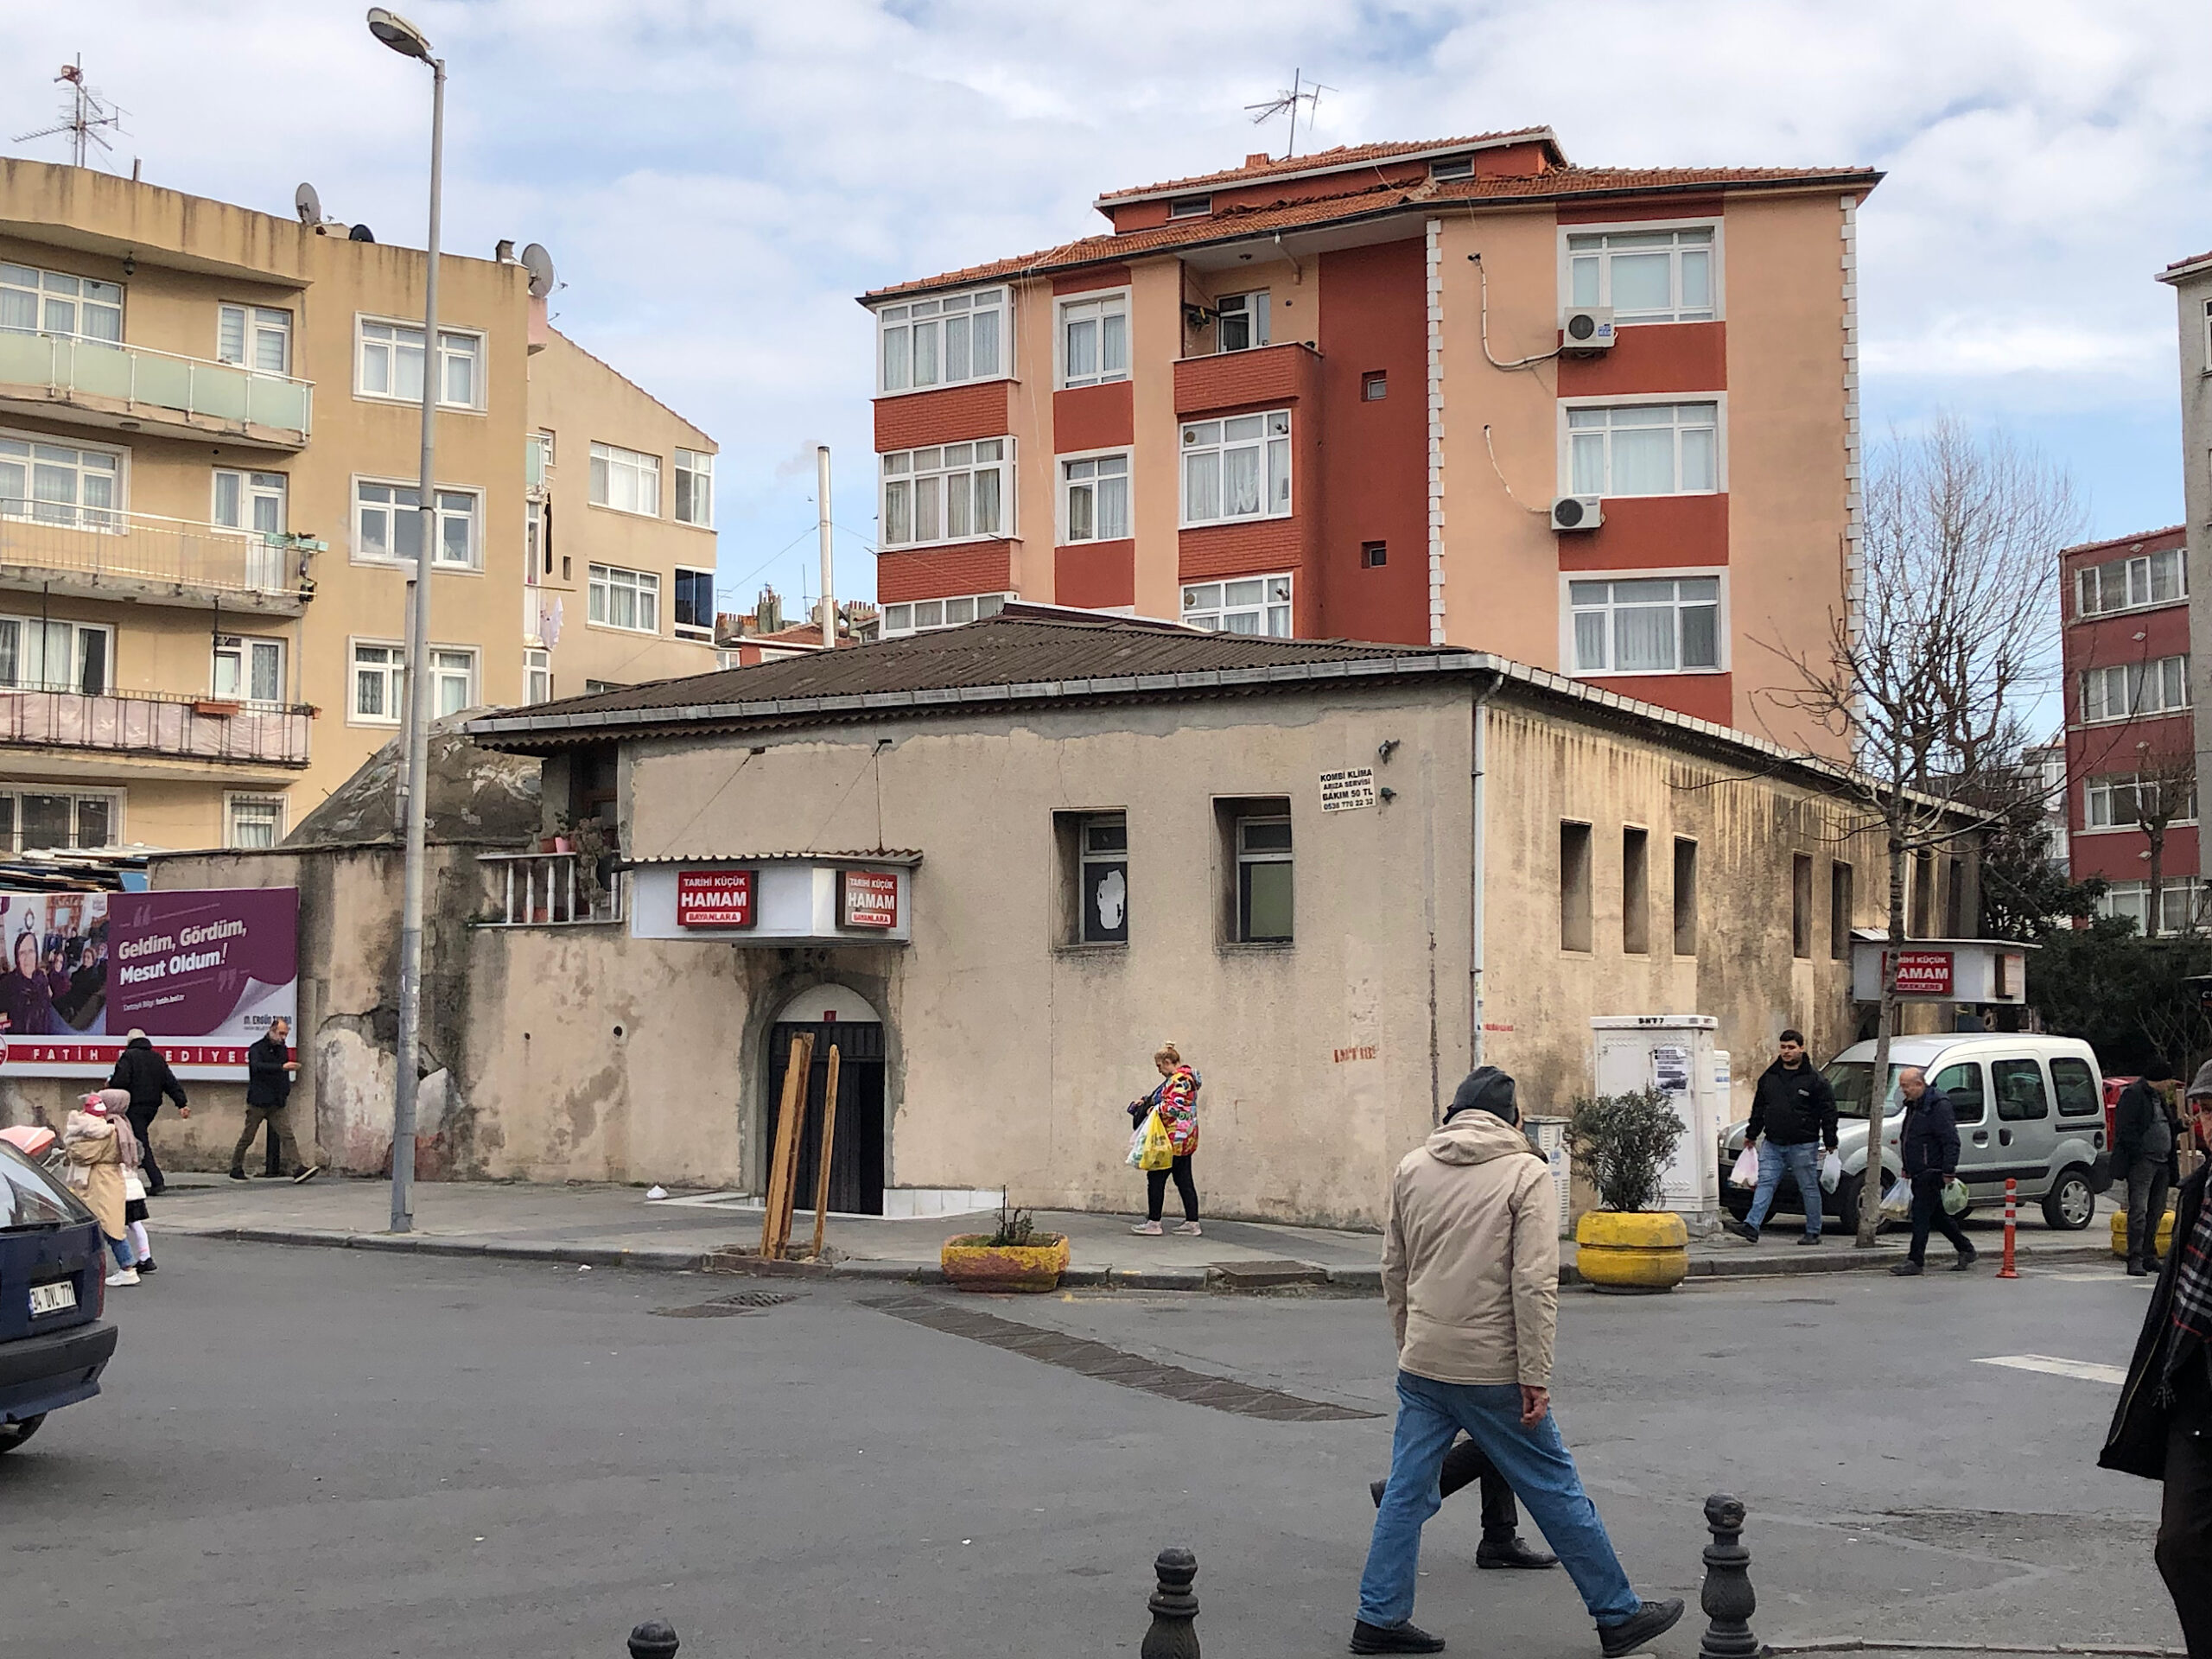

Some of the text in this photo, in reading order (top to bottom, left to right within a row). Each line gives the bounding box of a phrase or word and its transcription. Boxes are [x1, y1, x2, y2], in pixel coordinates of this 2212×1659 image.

[1322, 791, 1349, 801] BAKIM
[715, 875, 746, 888] KÜÇÜK
[681, 891, 747, 907] HAMAM
[848, 892, 895, 910] HAMAM
[688, 912, 738, 921] BAYANLARA
[118, 918, 247, 960] Geldim, Gördüm,
[119, 942, 229, 986] Mesut Oldum!
[1916, 955, 1947, 965] KÜÇÜK
[1897, 967, 1948, 980] AMAM
[33, 1046, 99, 1061] FATİH
